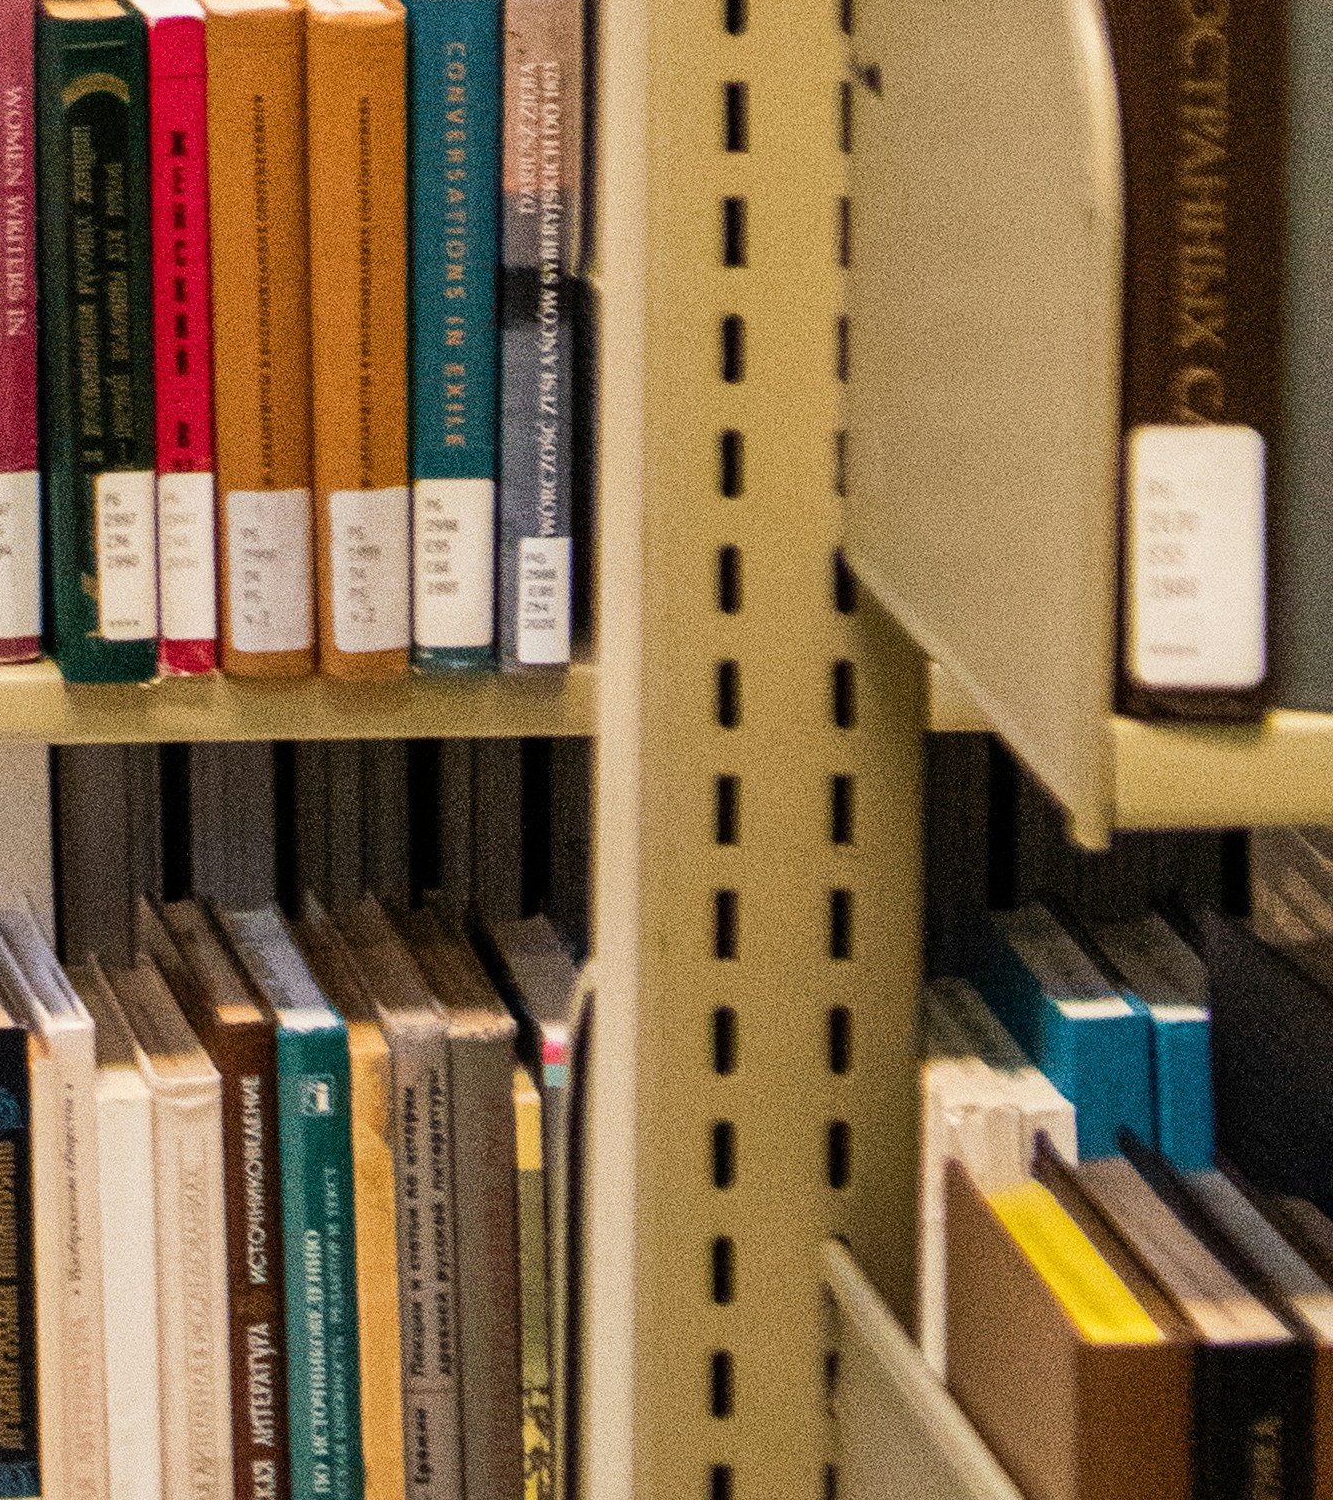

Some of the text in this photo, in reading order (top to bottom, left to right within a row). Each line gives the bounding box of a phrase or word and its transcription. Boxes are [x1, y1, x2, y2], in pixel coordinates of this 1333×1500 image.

[3, 83, 28, 338] WOMEN WRITERS IN
[442, 40, 467, 449] CONVERSATIONS IN EXILE
[536, 420, 563, 538] WÓRCZOŚĆ
[240, 1074, 277, 1448] ЛИТЕРАТУРА ИСТОЧНИКОВЕДЕНИЕ
[431, 1202, 452, 1284] русской
[312, 1462, 333, 1494] ПО
